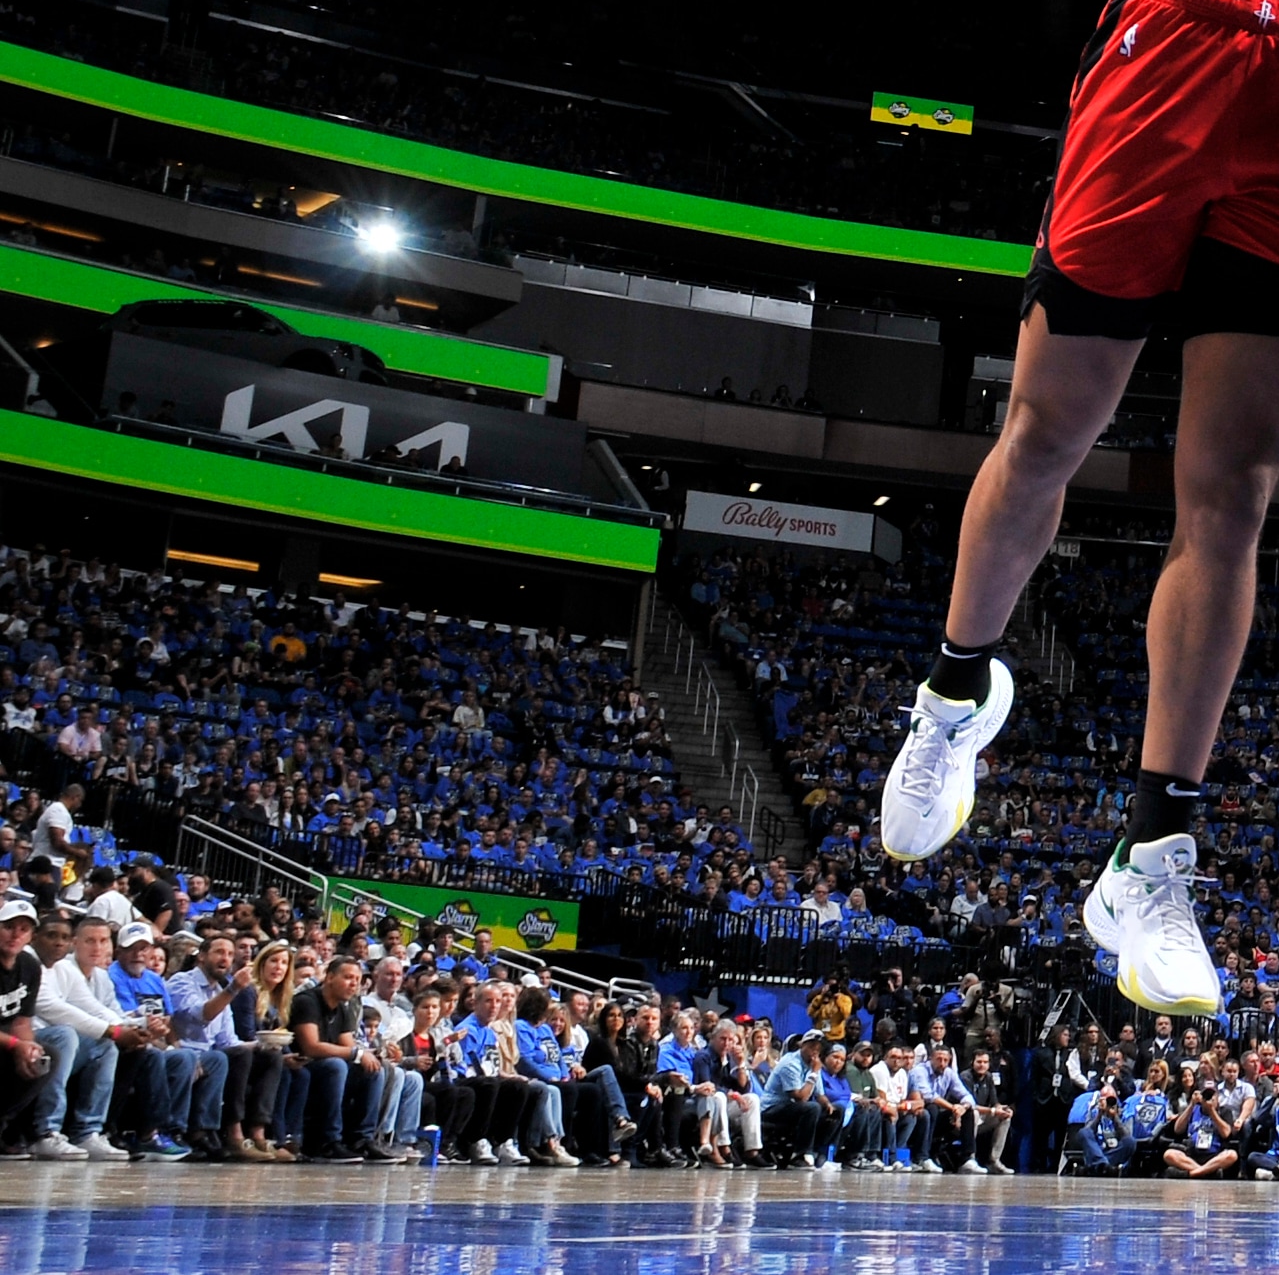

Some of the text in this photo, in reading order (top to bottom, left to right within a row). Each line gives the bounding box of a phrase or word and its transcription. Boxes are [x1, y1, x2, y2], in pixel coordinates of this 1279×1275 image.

[722, 502, 837, 537] Bally SPORTS
[438, 904, 479, 934] Starry
[518, 914, 558, 941] Starry
